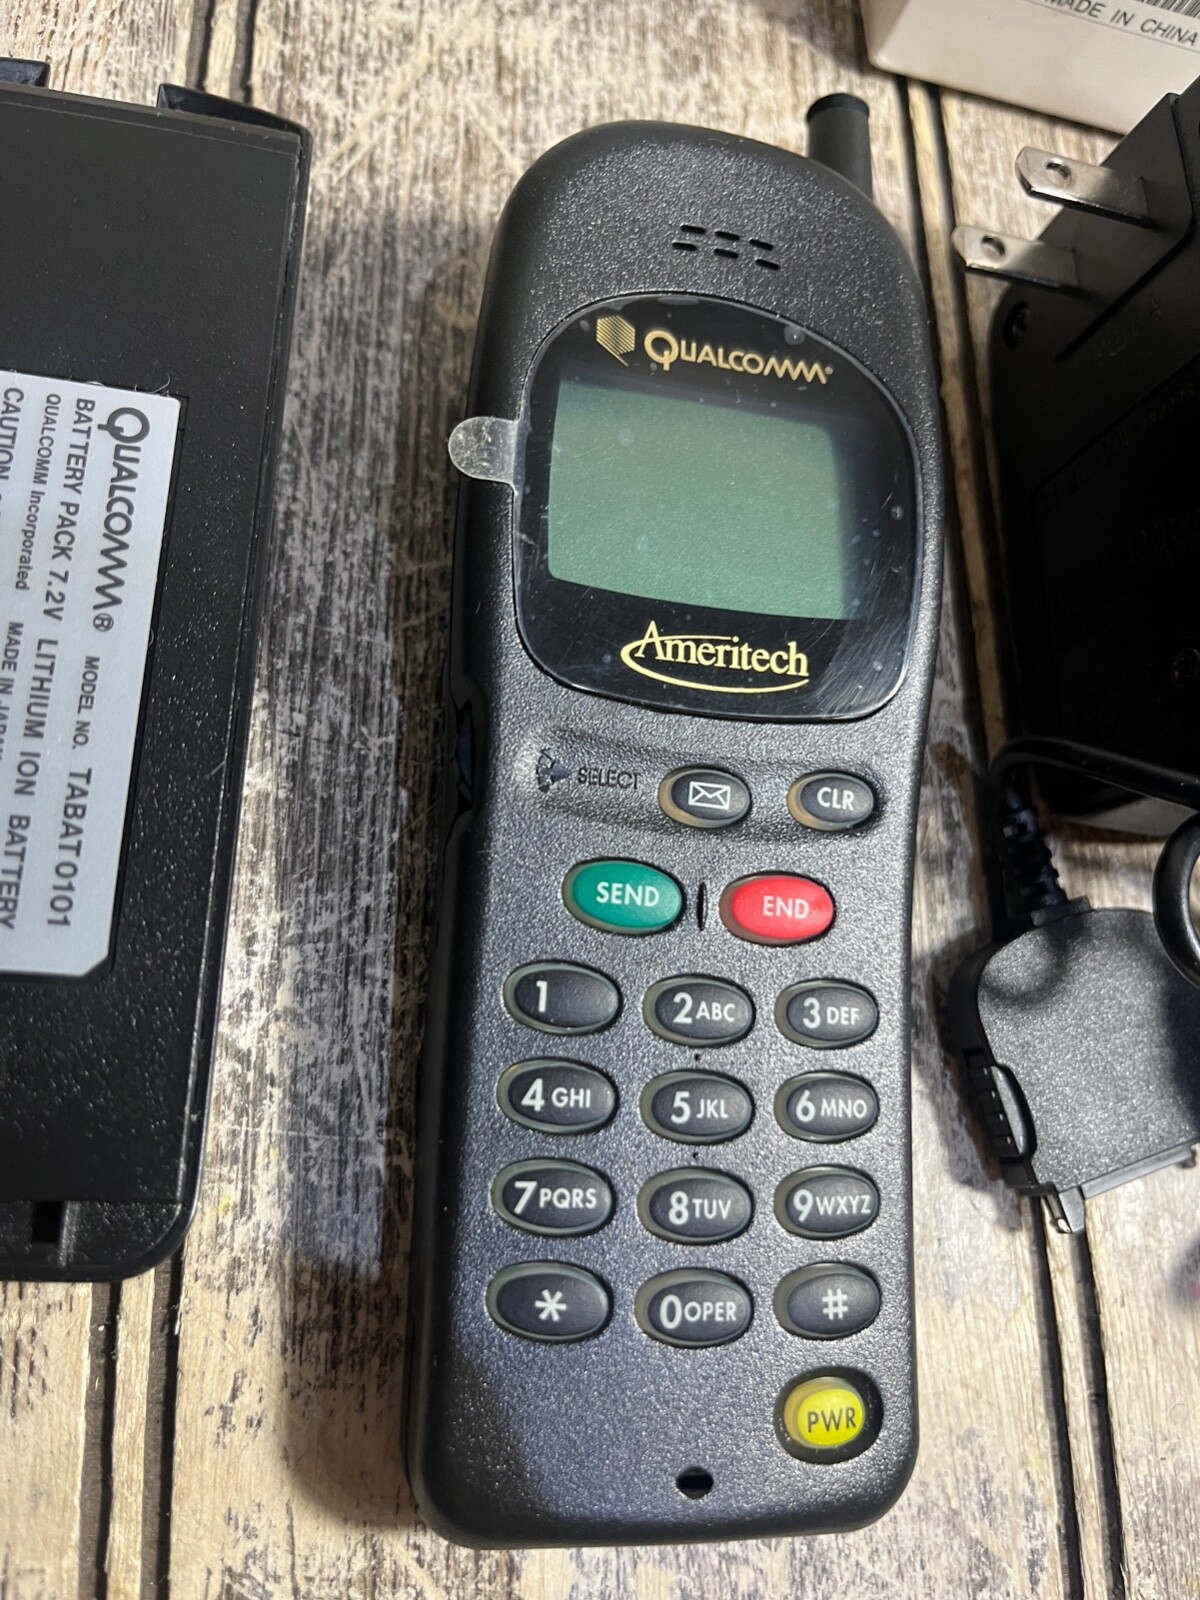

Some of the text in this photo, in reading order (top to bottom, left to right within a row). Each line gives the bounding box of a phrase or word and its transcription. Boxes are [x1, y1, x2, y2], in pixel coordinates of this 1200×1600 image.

[1109, 9, 1135, 27] IN
[1139, 18, 1199, 47] CHINA
[15, 393, 61, 591] QUALCOMM Incorporated
[1, 621, 24, 672] MADE
[634, 620, 810, 677] Ameritech
[0, 398, 96, 930] BATTERY PACK 7.2V LITHIUM ION BATTERY
[0, 677, 15, 695] IN
[76, 655, 100, 715] MODEL
[72, 720, 91, 750] NO.
[578, 766, 643, 790] SELECT
[816, 786, 855, 812] CLR
[595, 880, 661, 908] SEND
[762, 895, 810, 920] END
[535, 980, 548, 1013] 1
[696, 1002, 736, 1023] ABC
[826, 1005, 860, 1026] DEF
[521, 1078, 591, 1112] 4 GHI
[696, 1101, 729, 1120] JKL
[820, 1098, 868, 1120] MNO
[539, 1186, 597, 1209] PQRS
[692, 1198, 732, 1219] TUV
[815, 1194, 872, 1216] WXYZ
[683, 1300, 737, 1323] OPER
[821, 1288, 849, 1320] #
[806, 1405, 858, 1434] PWR
